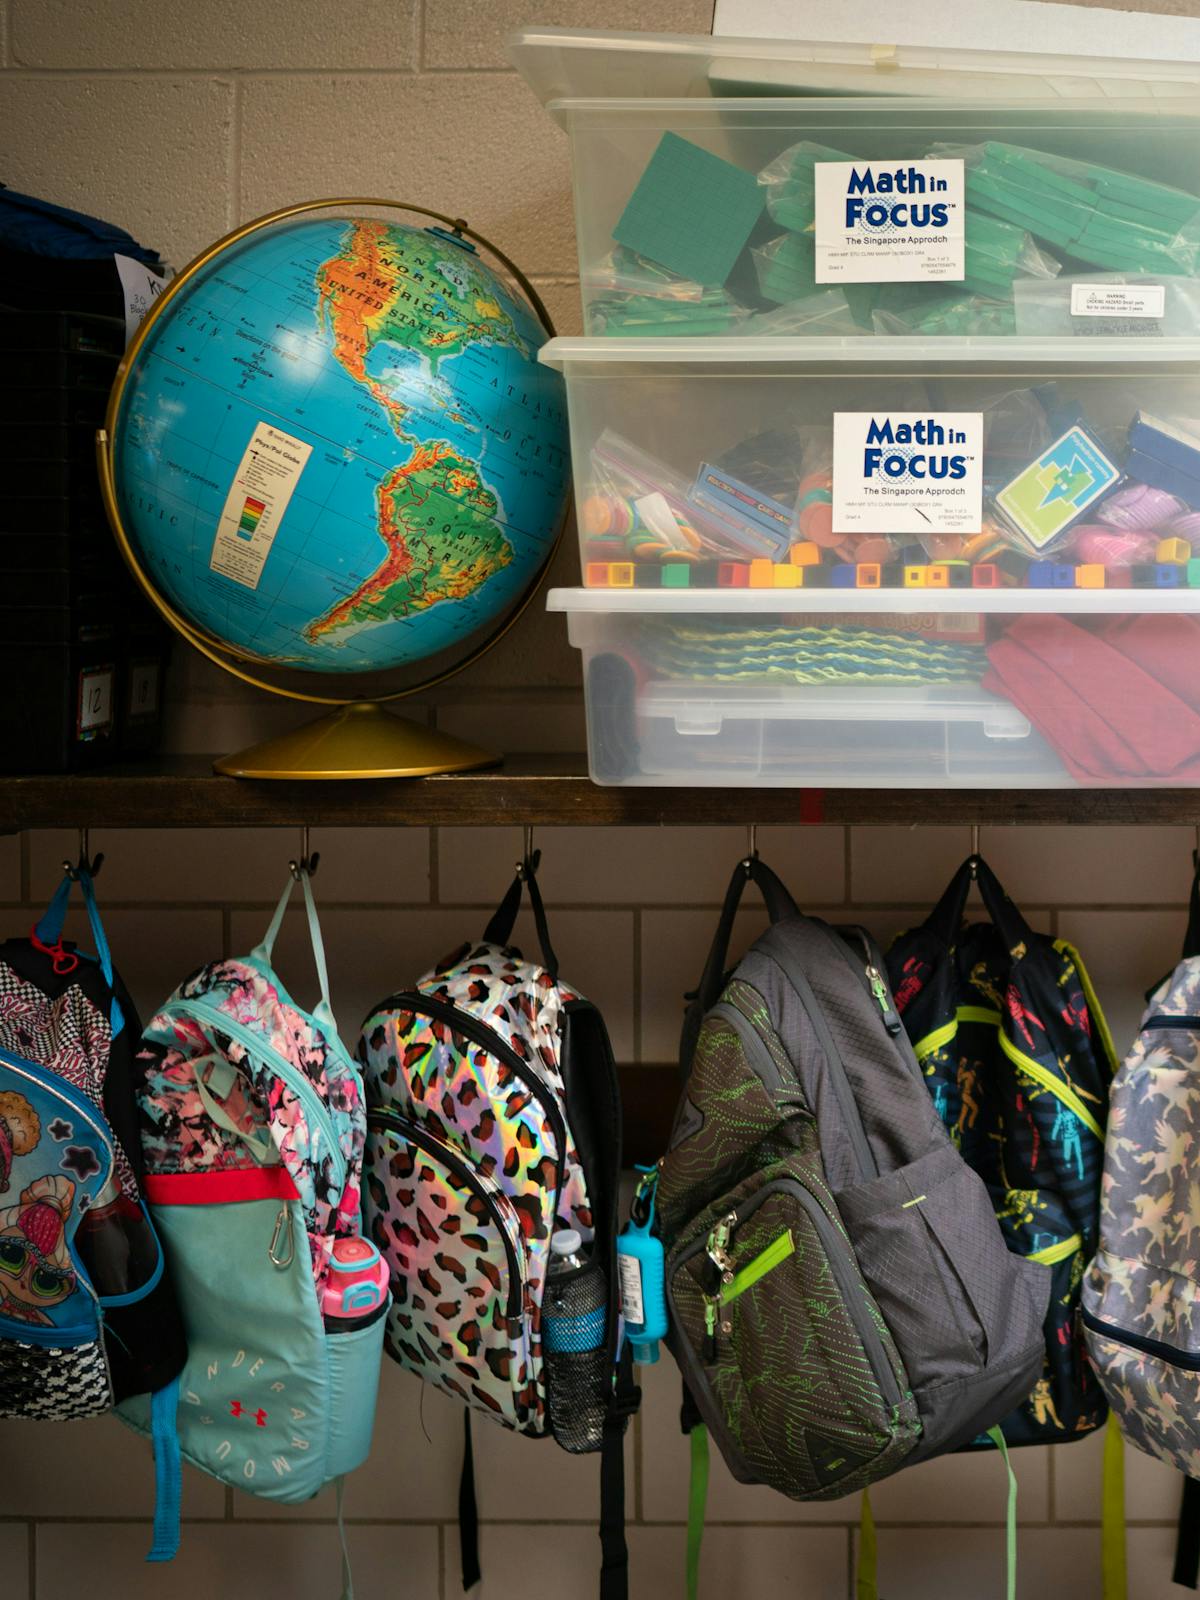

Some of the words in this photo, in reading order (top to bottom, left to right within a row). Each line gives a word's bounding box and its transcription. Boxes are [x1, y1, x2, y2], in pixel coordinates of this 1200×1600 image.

[847, 166, 926, 195] Math
[930, 176, 947, 192] in
[845, 198, 949, 228] FOCUS
[845, 237, 862, 245] The
[863, 236, 906, 246] Singapore
[377, 240, 481, 296] CANADA
[379, 257, 453, 298] NORTH
[329, 280, 384, 310] UNITED
[354, 271, 451, 322] AMERICA
[388, 309, 446, 342] STATES
[490, 376, 563, 423] ATLANT
[866, 417, 945, 446] Math
[948, 428, 967, 444] in
[282, 451, 300, 465] Globe
[863, 448, 967, 479] FOCUS
[863, 487, 880, 495] The
[881, 487, 924, 496] Singapore
[426, 516, 492, 552] SOUTH
[391, 529, 489, 578] AMERICA
[88, 687, 102, 714] 12
